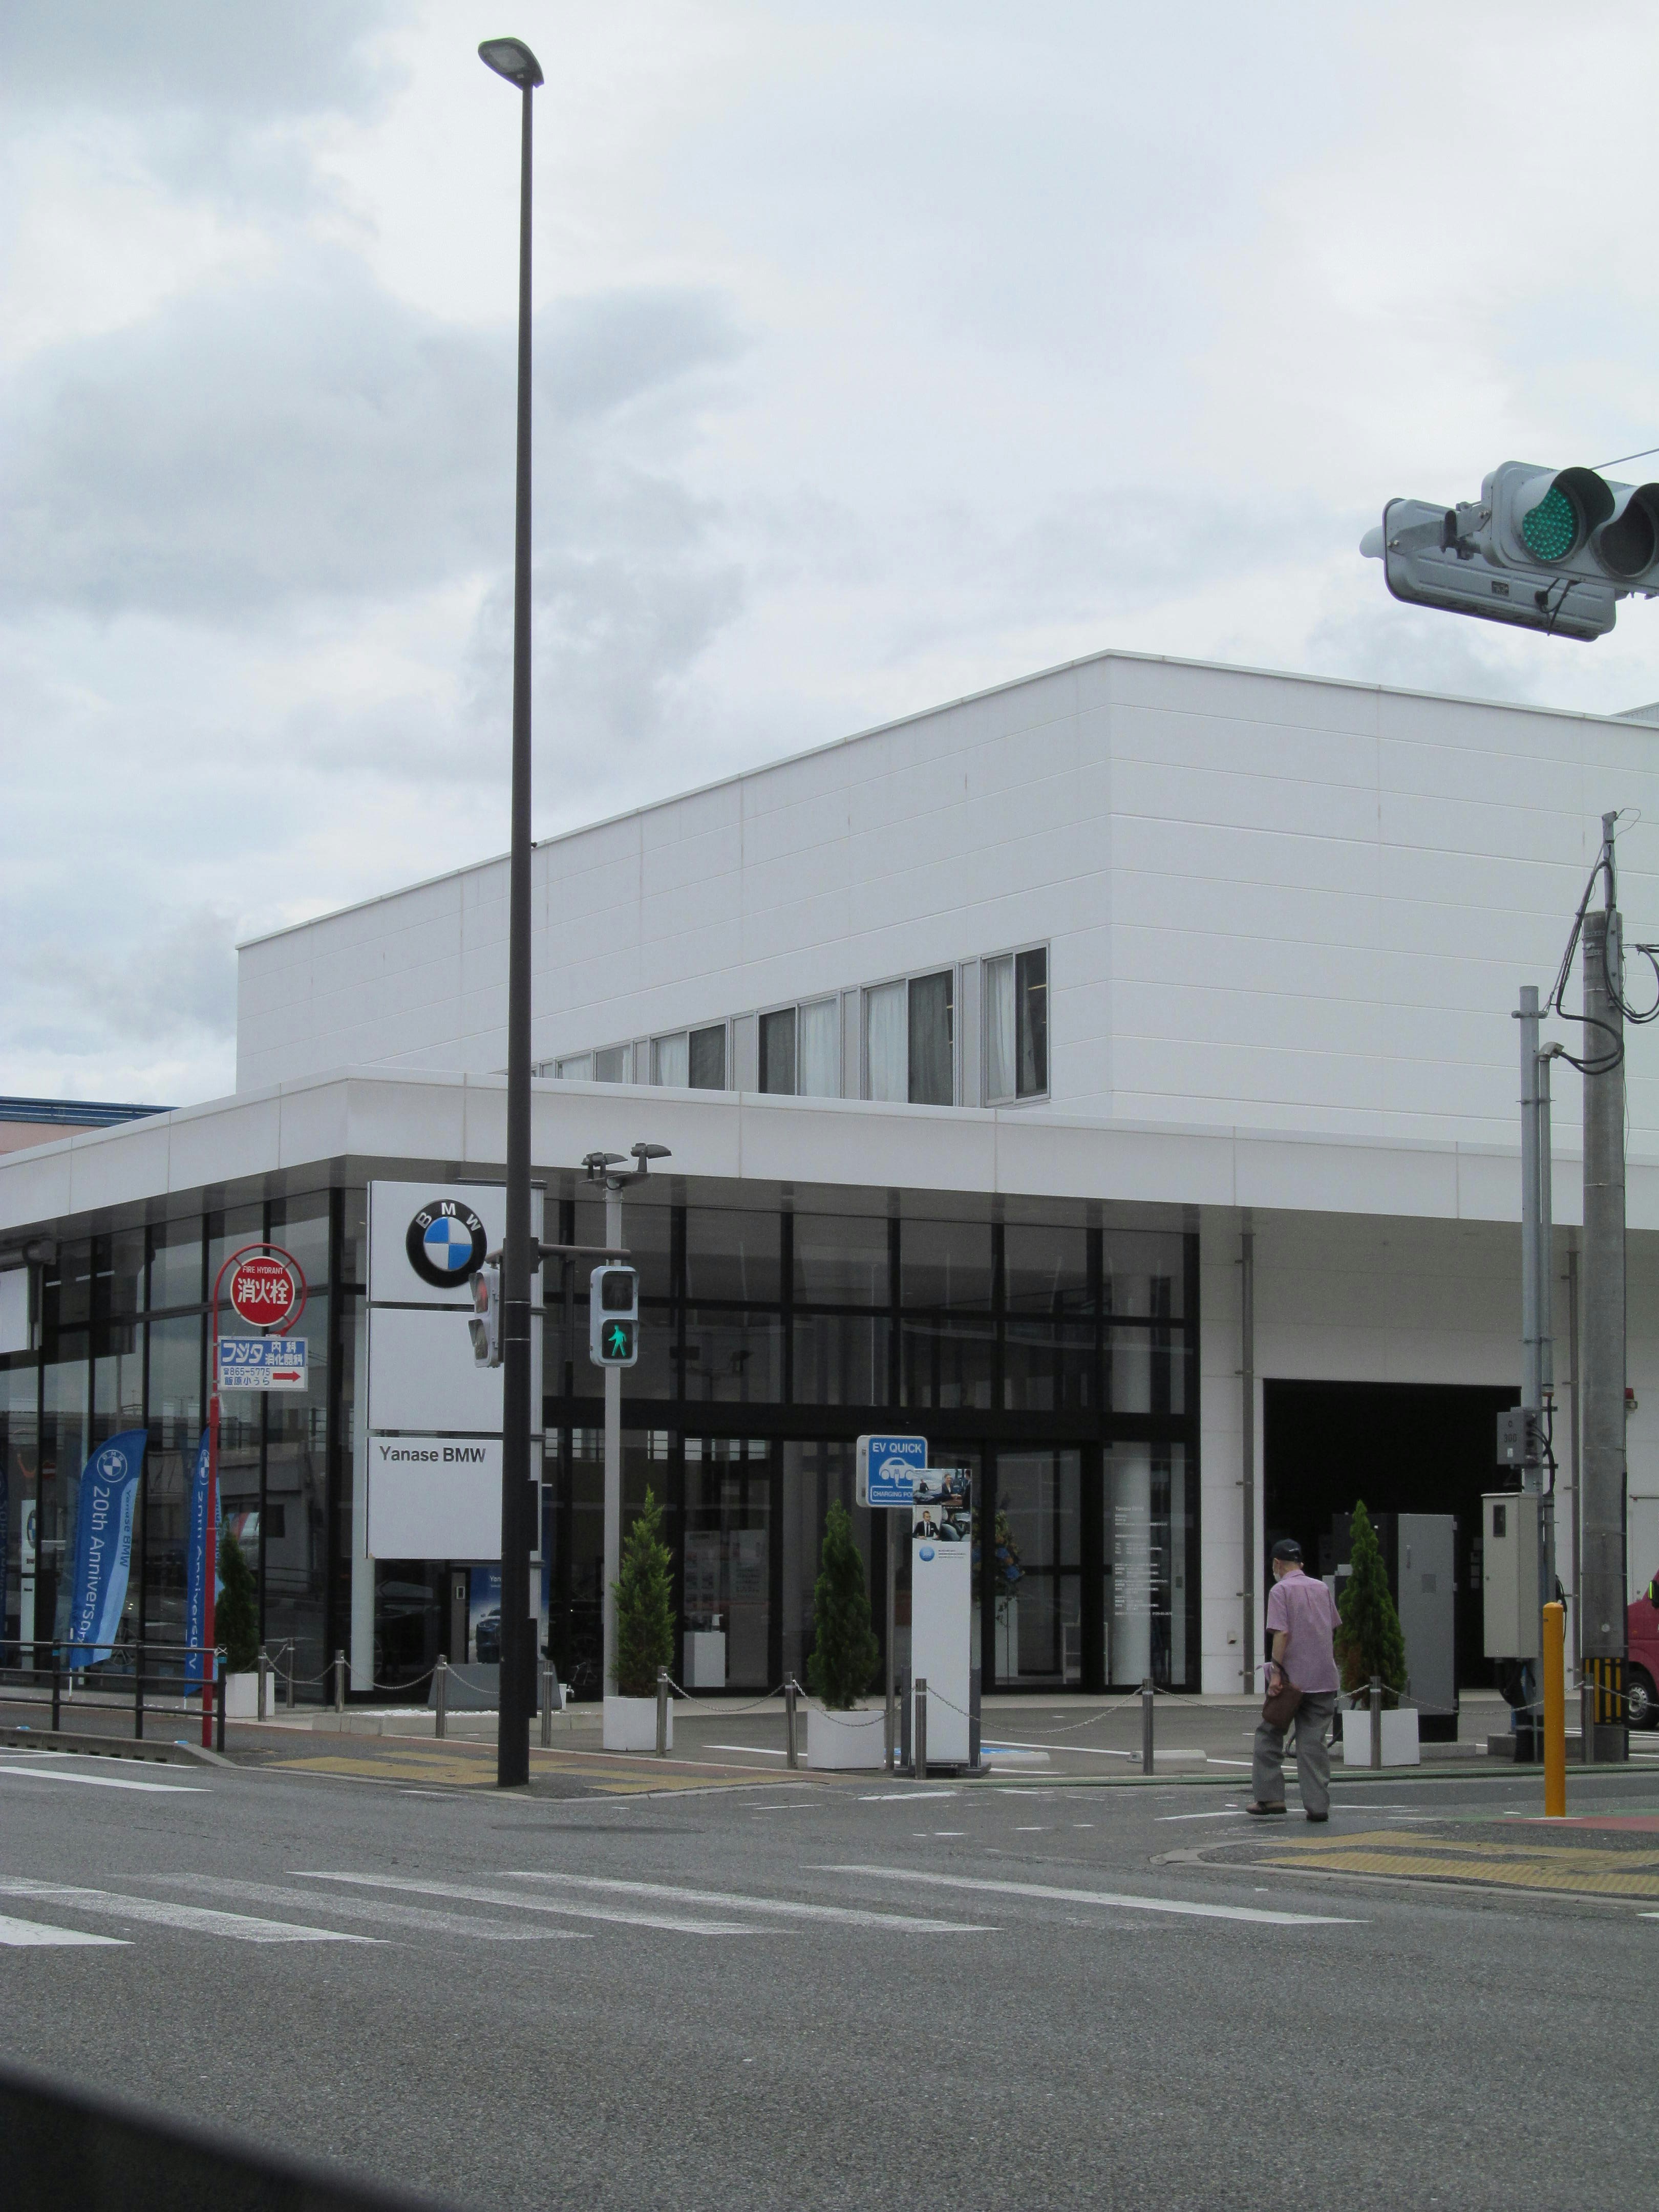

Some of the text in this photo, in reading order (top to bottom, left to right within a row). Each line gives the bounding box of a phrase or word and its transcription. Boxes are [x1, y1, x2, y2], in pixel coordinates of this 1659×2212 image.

[416, 1202, 481, 1231] BMW
[238, 1278, 289, 1304] 消火栓
[222, 1343, 264, 1364] フジタ
[271, 1341, 296, 1353] 内科
[379, 1445, 486, 1463] Yanase BMW
[873, 1442, 922, 1453] EV QUICK
[120, 1536, 131, 1567] BMW
[77, 1486, 110, 1644] 20th Anniversary
